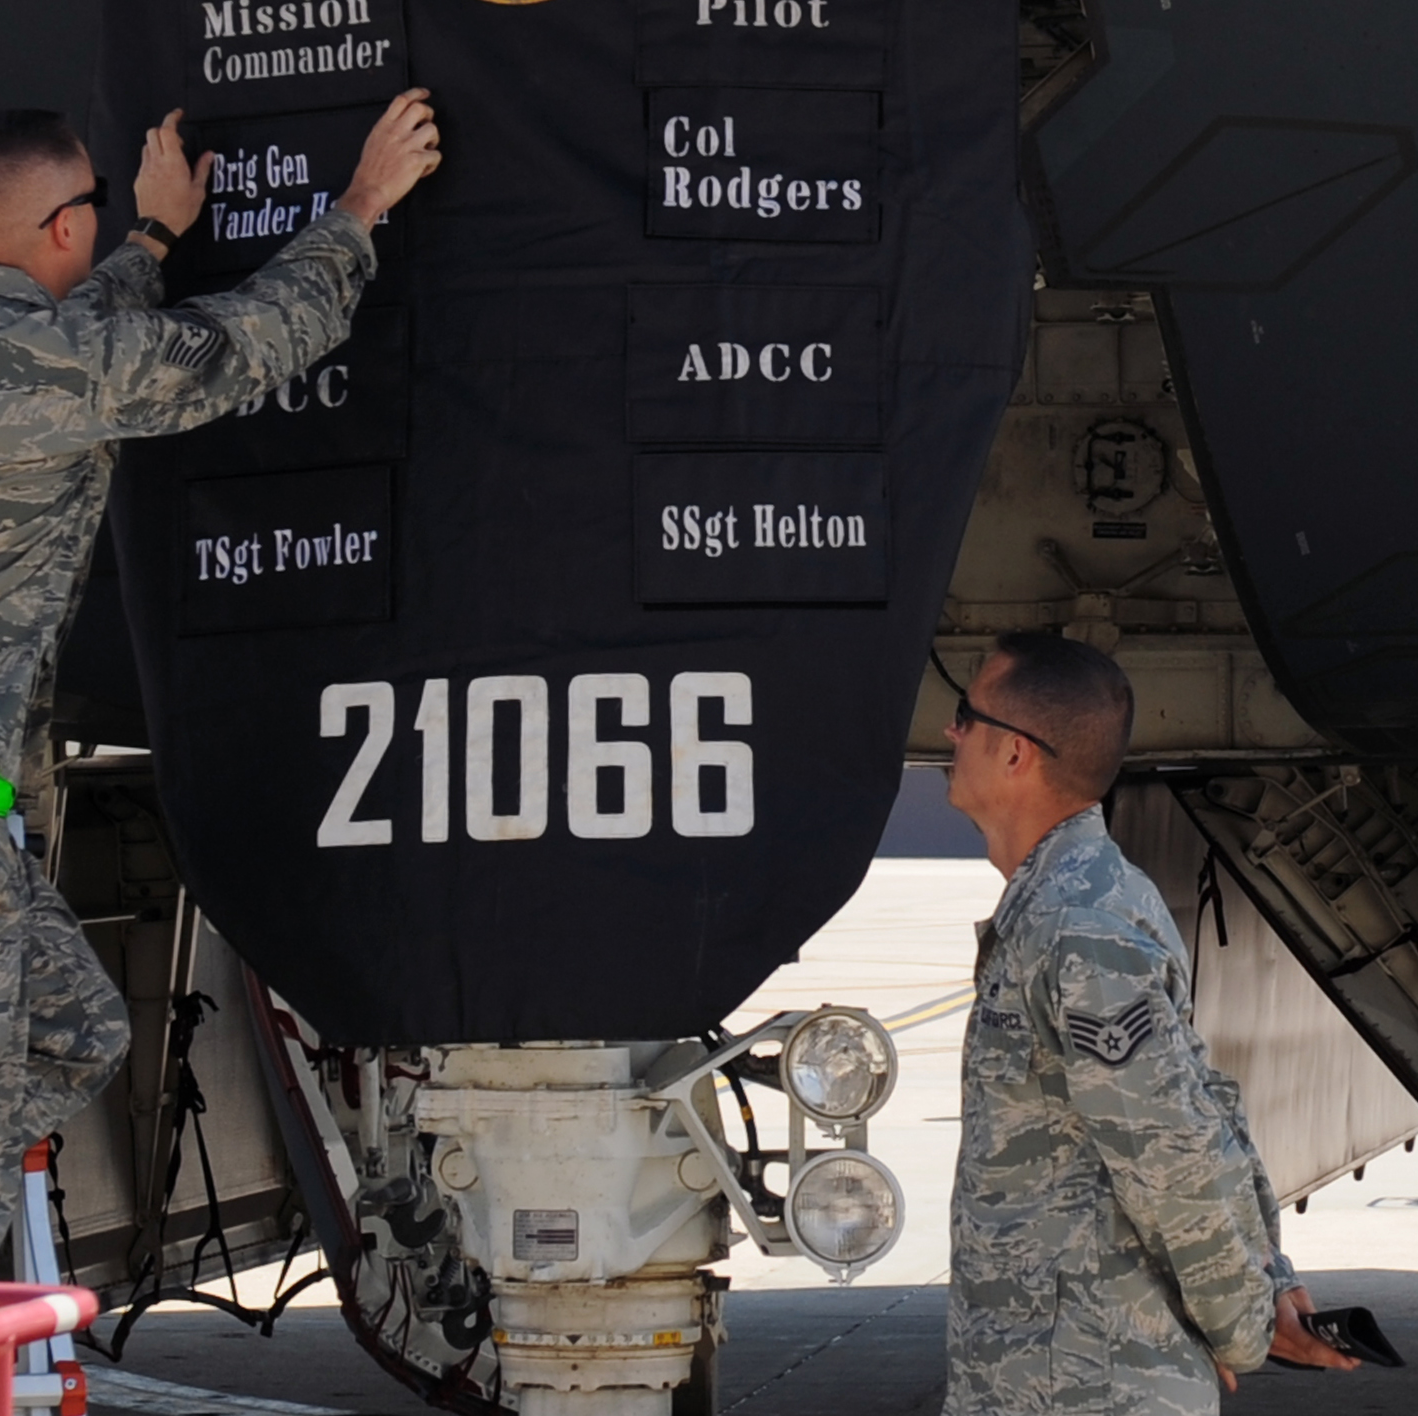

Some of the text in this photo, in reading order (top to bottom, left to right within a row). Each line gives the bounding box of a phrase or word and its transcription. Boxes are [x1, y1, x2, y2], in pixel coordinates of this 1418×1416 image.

[203, 33, 391, 85] Commander
[663, 115, 736, 158] Col
[212, 144, 310, 199] Brig Gen
[662, 166, 863, 219] Rodgers
[211, 197, 301, 242] Vander
[677, 341, 833, 383] ADCC
[195, 522, 378, 585] TSgt Fowler
[661, 503, 867, 558] SSgt Helton
[316, 670, 755, 848] 21066
